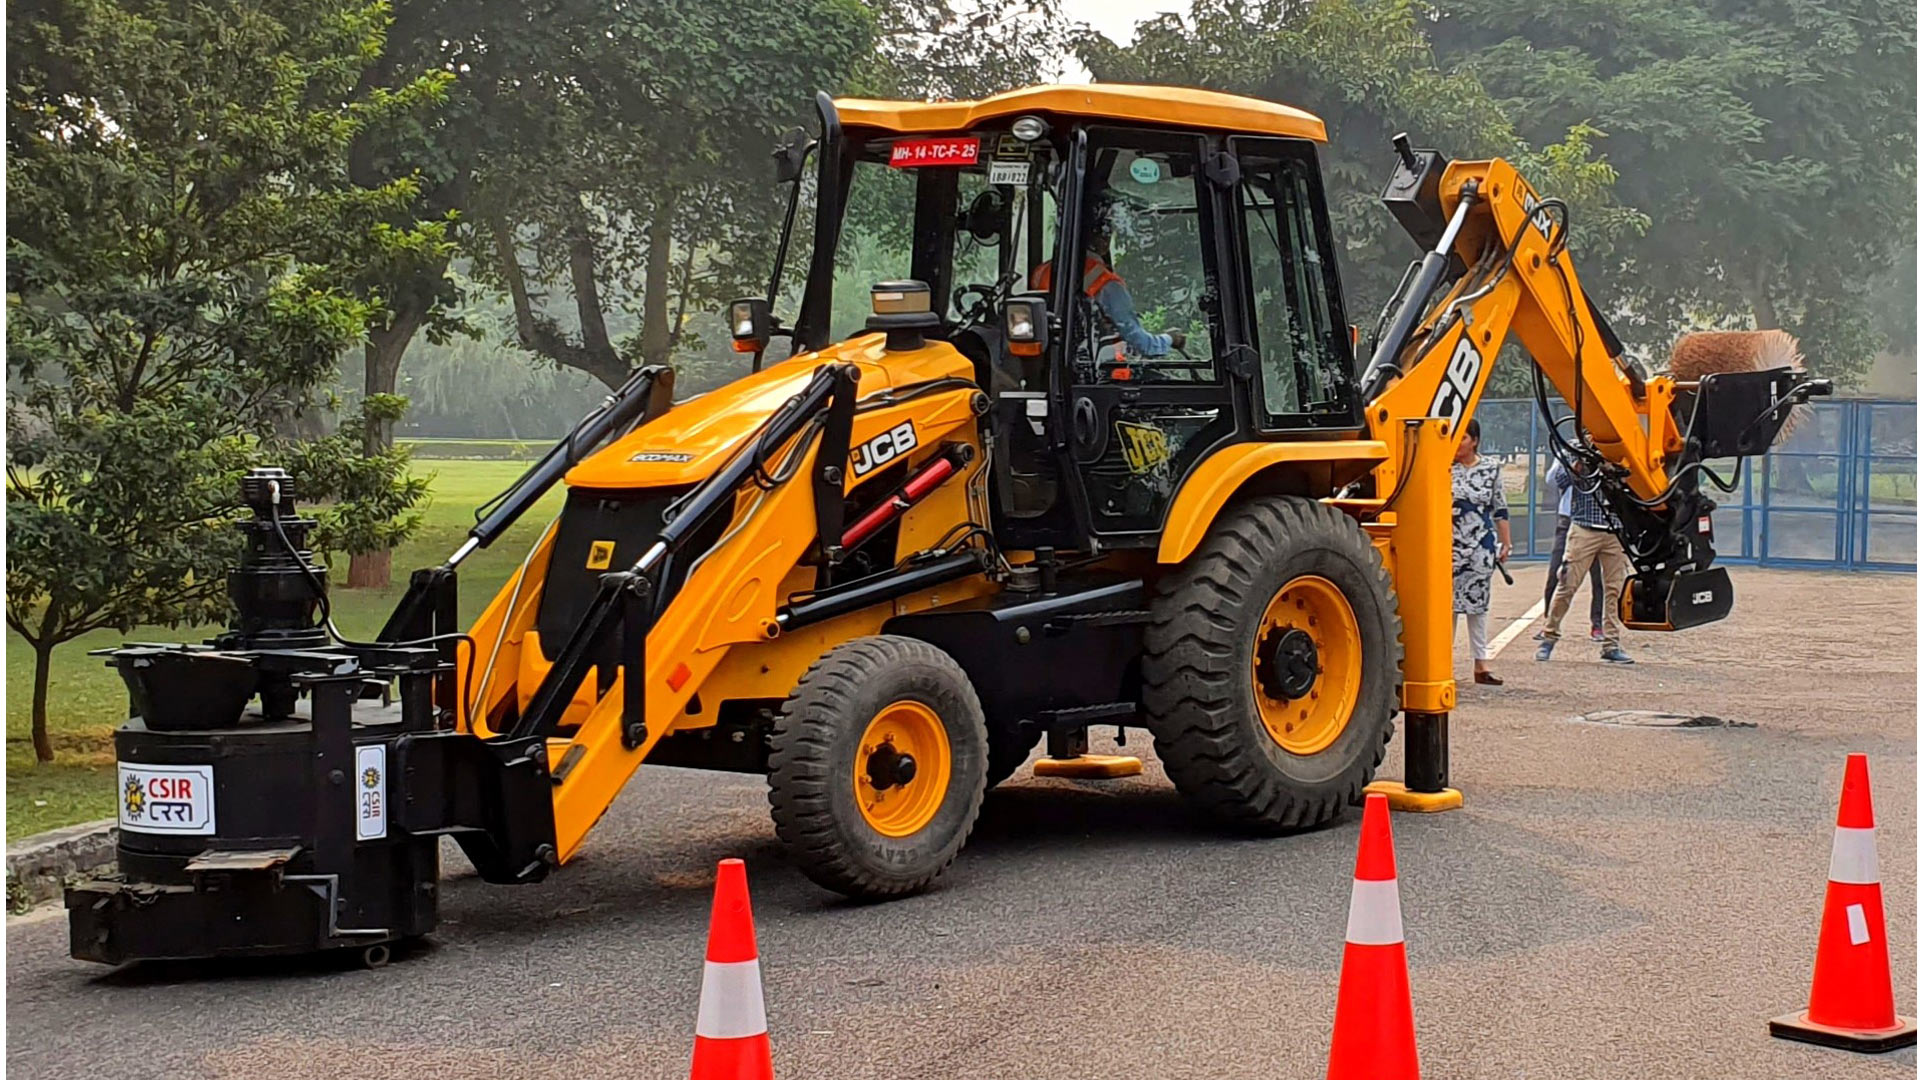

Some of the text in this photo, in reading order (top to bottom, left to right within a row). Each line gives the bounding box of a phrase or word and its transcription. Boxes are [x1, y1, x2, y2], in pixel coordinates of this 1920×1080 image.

[1430, 337, 1480, 434] CB
[854, 422, 917, 475] JCB
[1692, 590, 1713, 605] JCB
[148, 778, 193, 799] CSIR
[371, 791, 381, 818] CSIR
